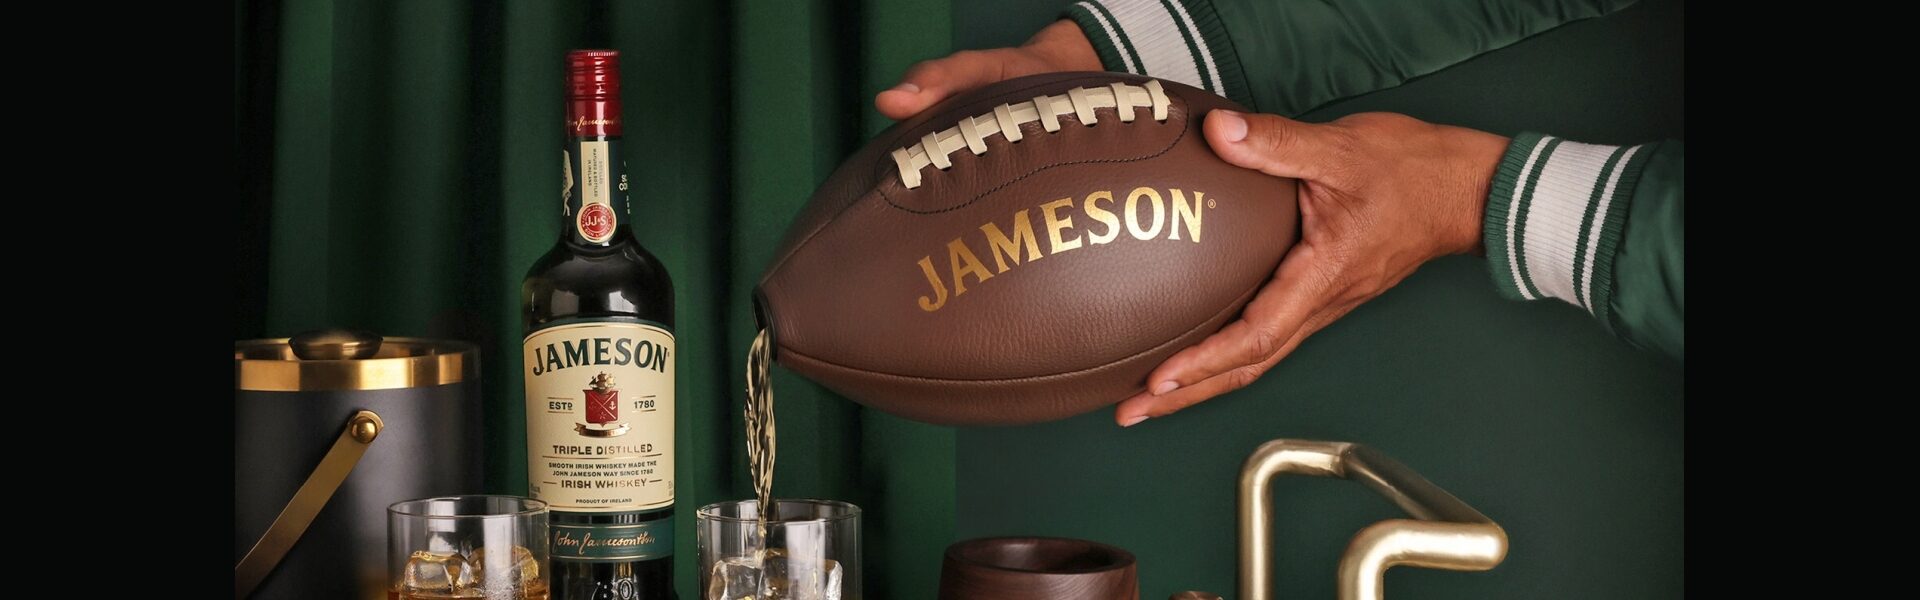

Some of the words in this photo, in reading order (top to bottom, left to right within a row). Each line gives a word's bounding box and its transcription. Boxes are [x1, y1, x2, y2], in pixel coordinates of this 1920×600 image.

[533, 338, 668, 376] JAMESON
[634, 399, 655, 409] 1780
[553, 445, 592, 455] TRIPLE
[596, 443, 653, 455] DISTILLED
[595, 462, 627, 470] WHISKEY
[561, 479, 592, 489] IRISH
[595, 478, 648, 489] WHISKEY
[552, 530, 579, 553] John
